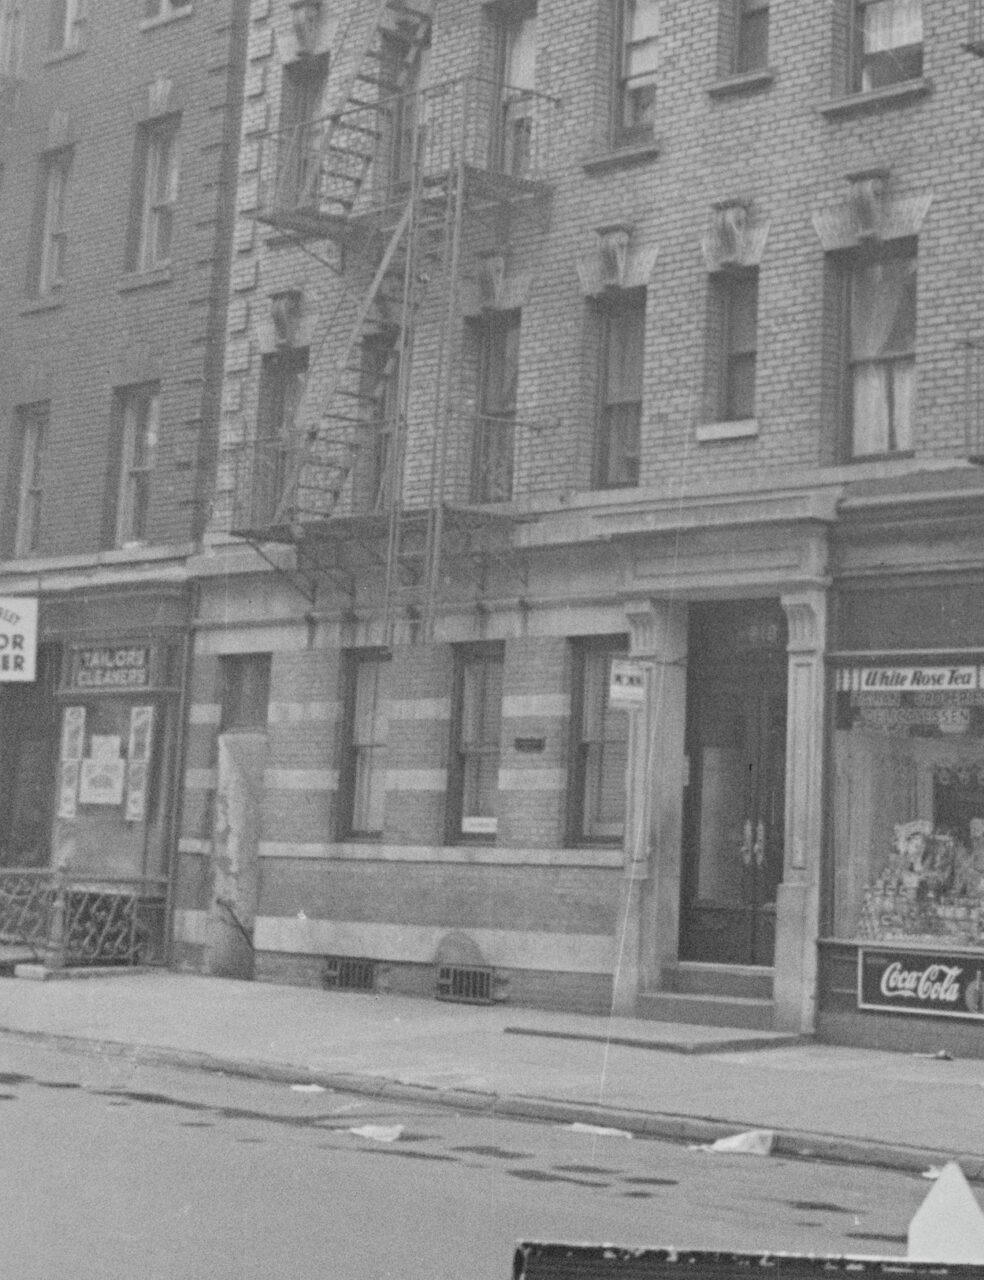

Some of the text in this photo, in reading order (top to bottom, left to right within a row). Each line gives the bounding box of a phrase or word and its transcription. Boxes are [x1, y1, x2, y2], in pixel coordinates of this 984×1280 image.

[865, 669, 972, 687] White Rose Tea
[880, 961, 963, 1002] Coca-Cola
